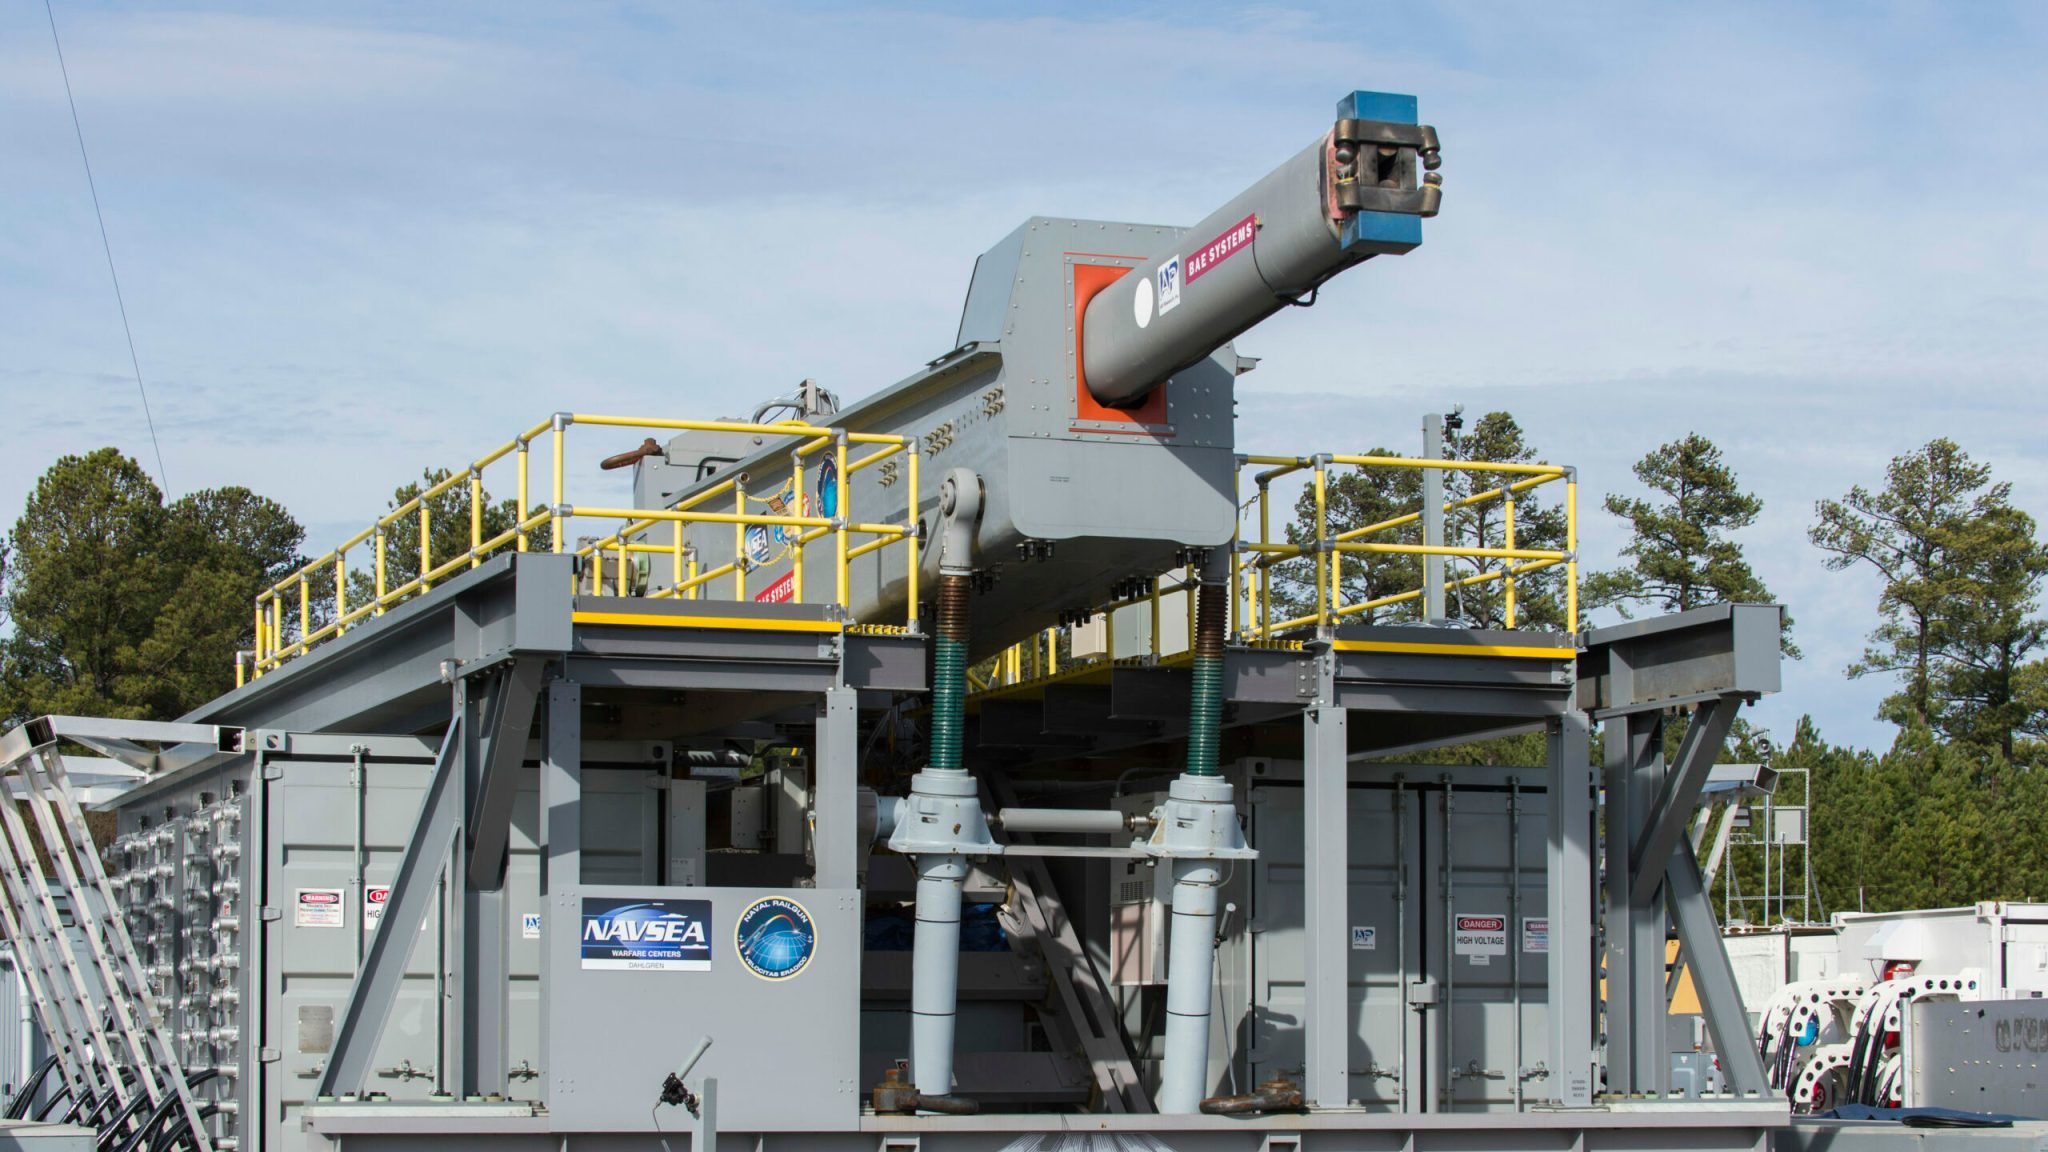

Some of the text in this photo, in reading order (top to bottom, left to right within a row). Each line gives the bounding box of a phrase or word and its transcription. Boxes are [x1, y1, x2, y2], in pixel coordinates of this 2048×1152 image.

[1188, 222, 1252, 277] BAE SYSTEMS
[367, 909, 381, 918] HIG
[744, 900, 809, 923] NAVAL RAILGUN
[583, 919, 706, 943] NAVSEA
[1463, 920, 1497, 928] DANGER
[1457, 936, 1504, 945] HIGH VOLTAGE
[611, 950, 682, 958] WARFARE CENTERS
[745, 956, 808, 977] VELOCITAS ERADICO
